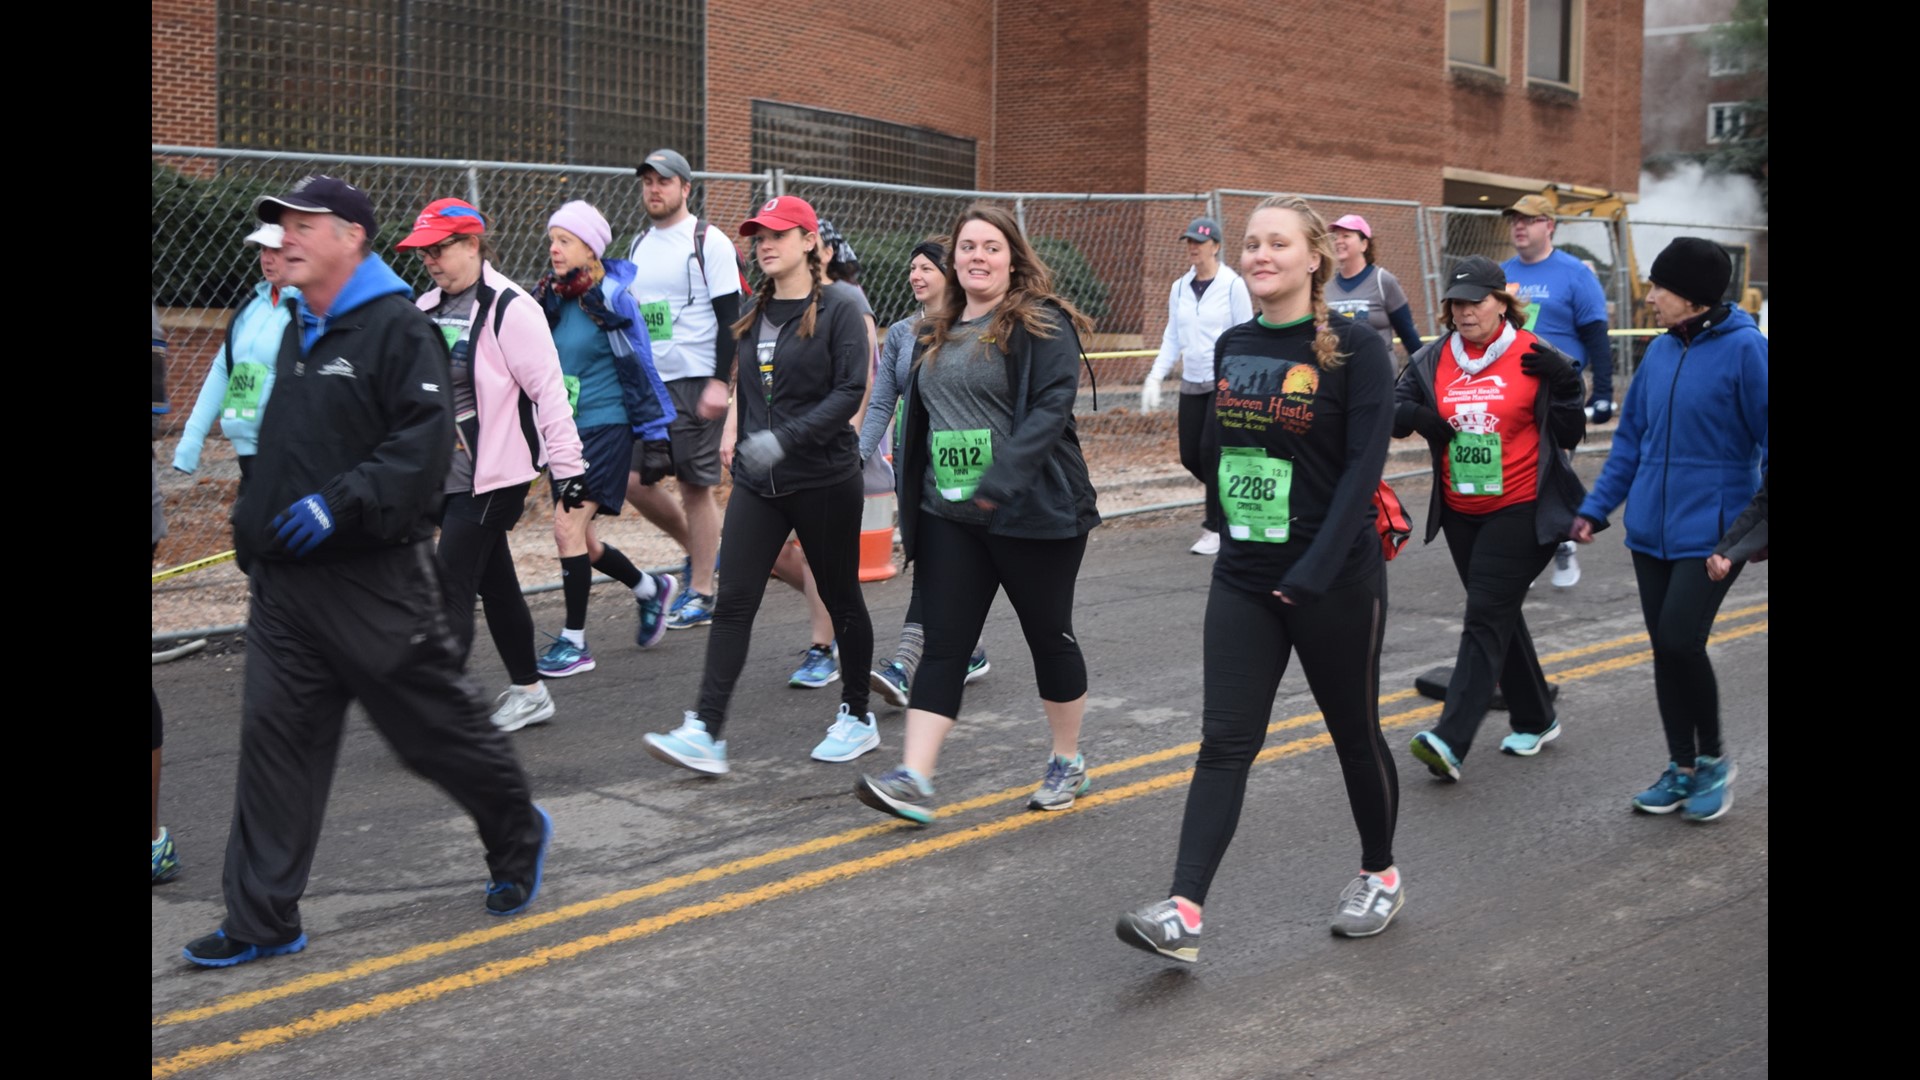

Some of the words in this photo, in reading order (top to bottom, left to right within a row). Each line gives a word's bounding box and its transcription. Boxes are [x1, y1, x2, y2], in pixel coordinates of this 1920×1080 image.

[764, 198, 779, 211] O
[1267, 396, 1315, 421] Hustle
[938, 446, 983, 467] 2612
[1455, 445, 1492, 465] 3280
[1272, 468, 1288, 478] 13.1
[1227, 475, 1277, 502] 2288
[1163, 920, 1180, 941] N
